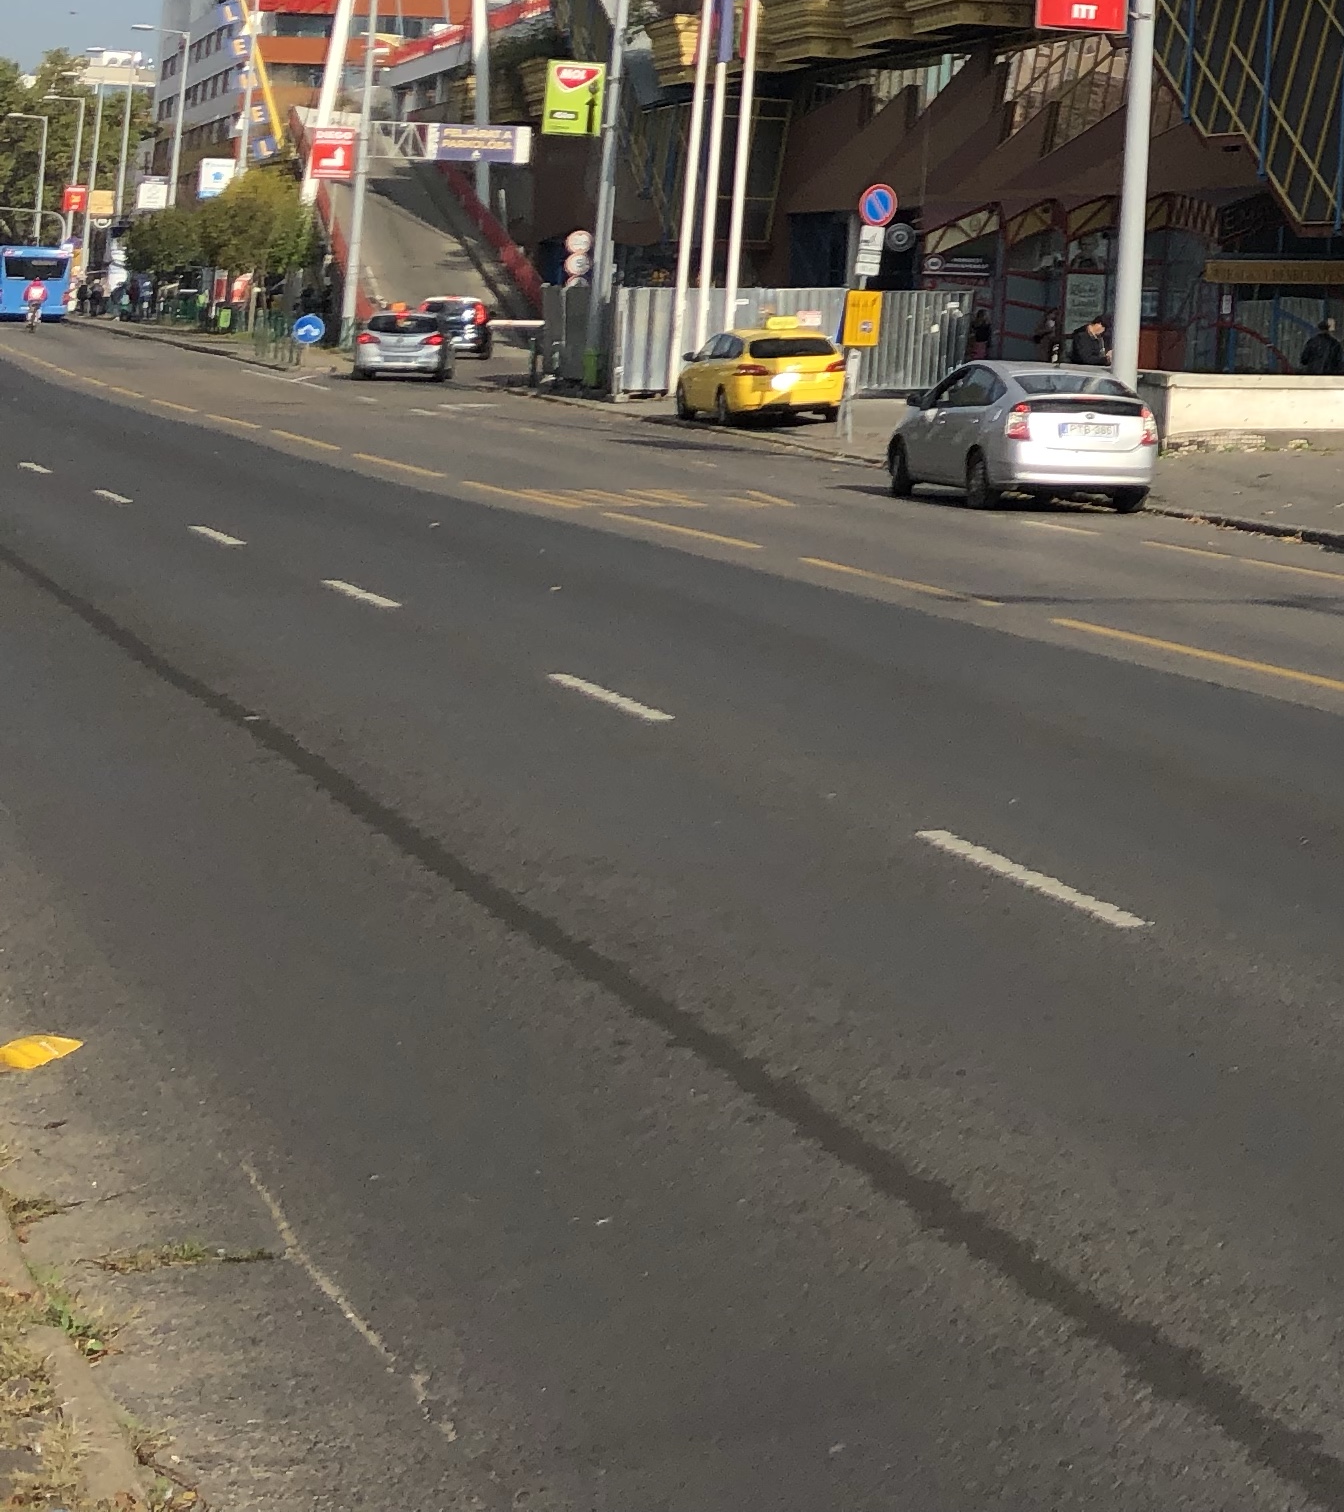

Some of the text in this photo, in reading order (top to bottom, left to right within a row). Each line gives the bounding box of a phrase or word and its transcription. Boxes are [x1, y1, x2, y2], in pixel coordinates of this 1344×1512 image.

[1071, 3, 1098, 20] ITT
[315, 129, 353, 140] DIEGO
[501, 130, 513, 140] A
